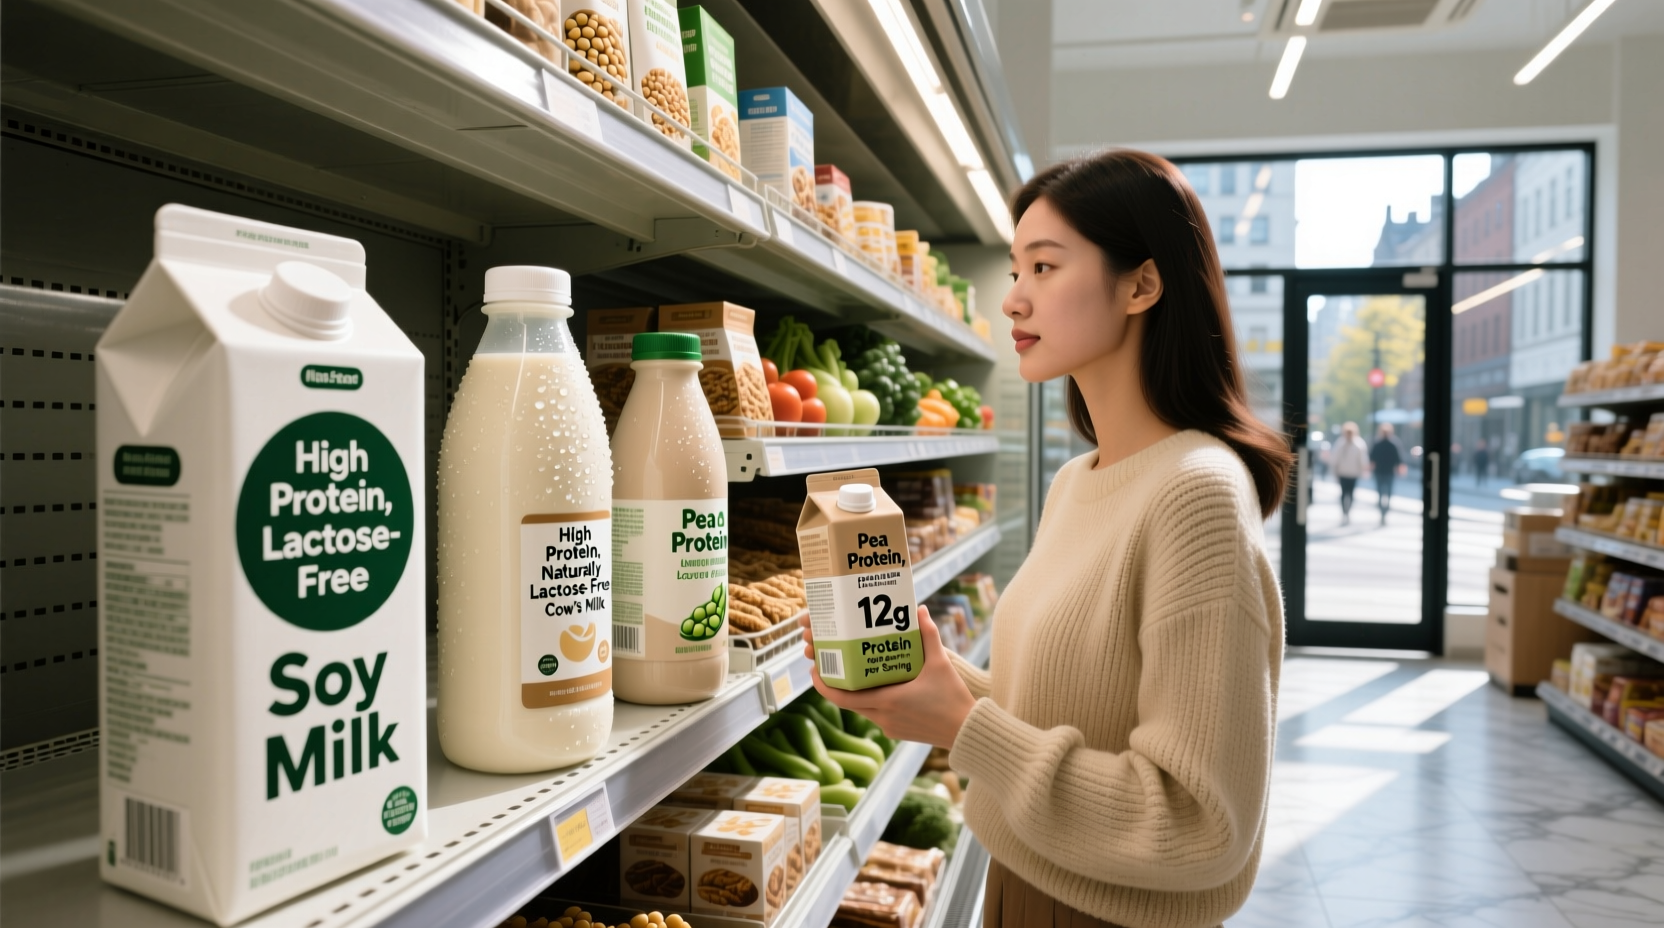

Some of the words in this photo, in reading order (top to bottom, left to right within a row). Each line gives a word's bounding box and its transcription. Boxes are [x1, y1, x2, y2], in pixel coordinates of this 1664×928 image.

[296, 439, 369, 482] High
[270, 478, 393, 517] Protein,
[682, 508, 716, 530] Pea
[262, 523, 401, 561] Lactose-
[559, 525, 591, 546] High
[857, 532, 888, 549] Pea
[541, 560, 601, 580] Naturally
[847, 549, 906, 570] Protein,
[297, 564, 370, 599] Free
[530, 583, 588, 599] Lactose
[545, 600, 582, 617] Cow's
[857, 594, 910, 631] 12g
[862, 636, 912, 656] Protein
[268, 651, 388, 717] Soy
[266, 711, 400, 802] Milk
